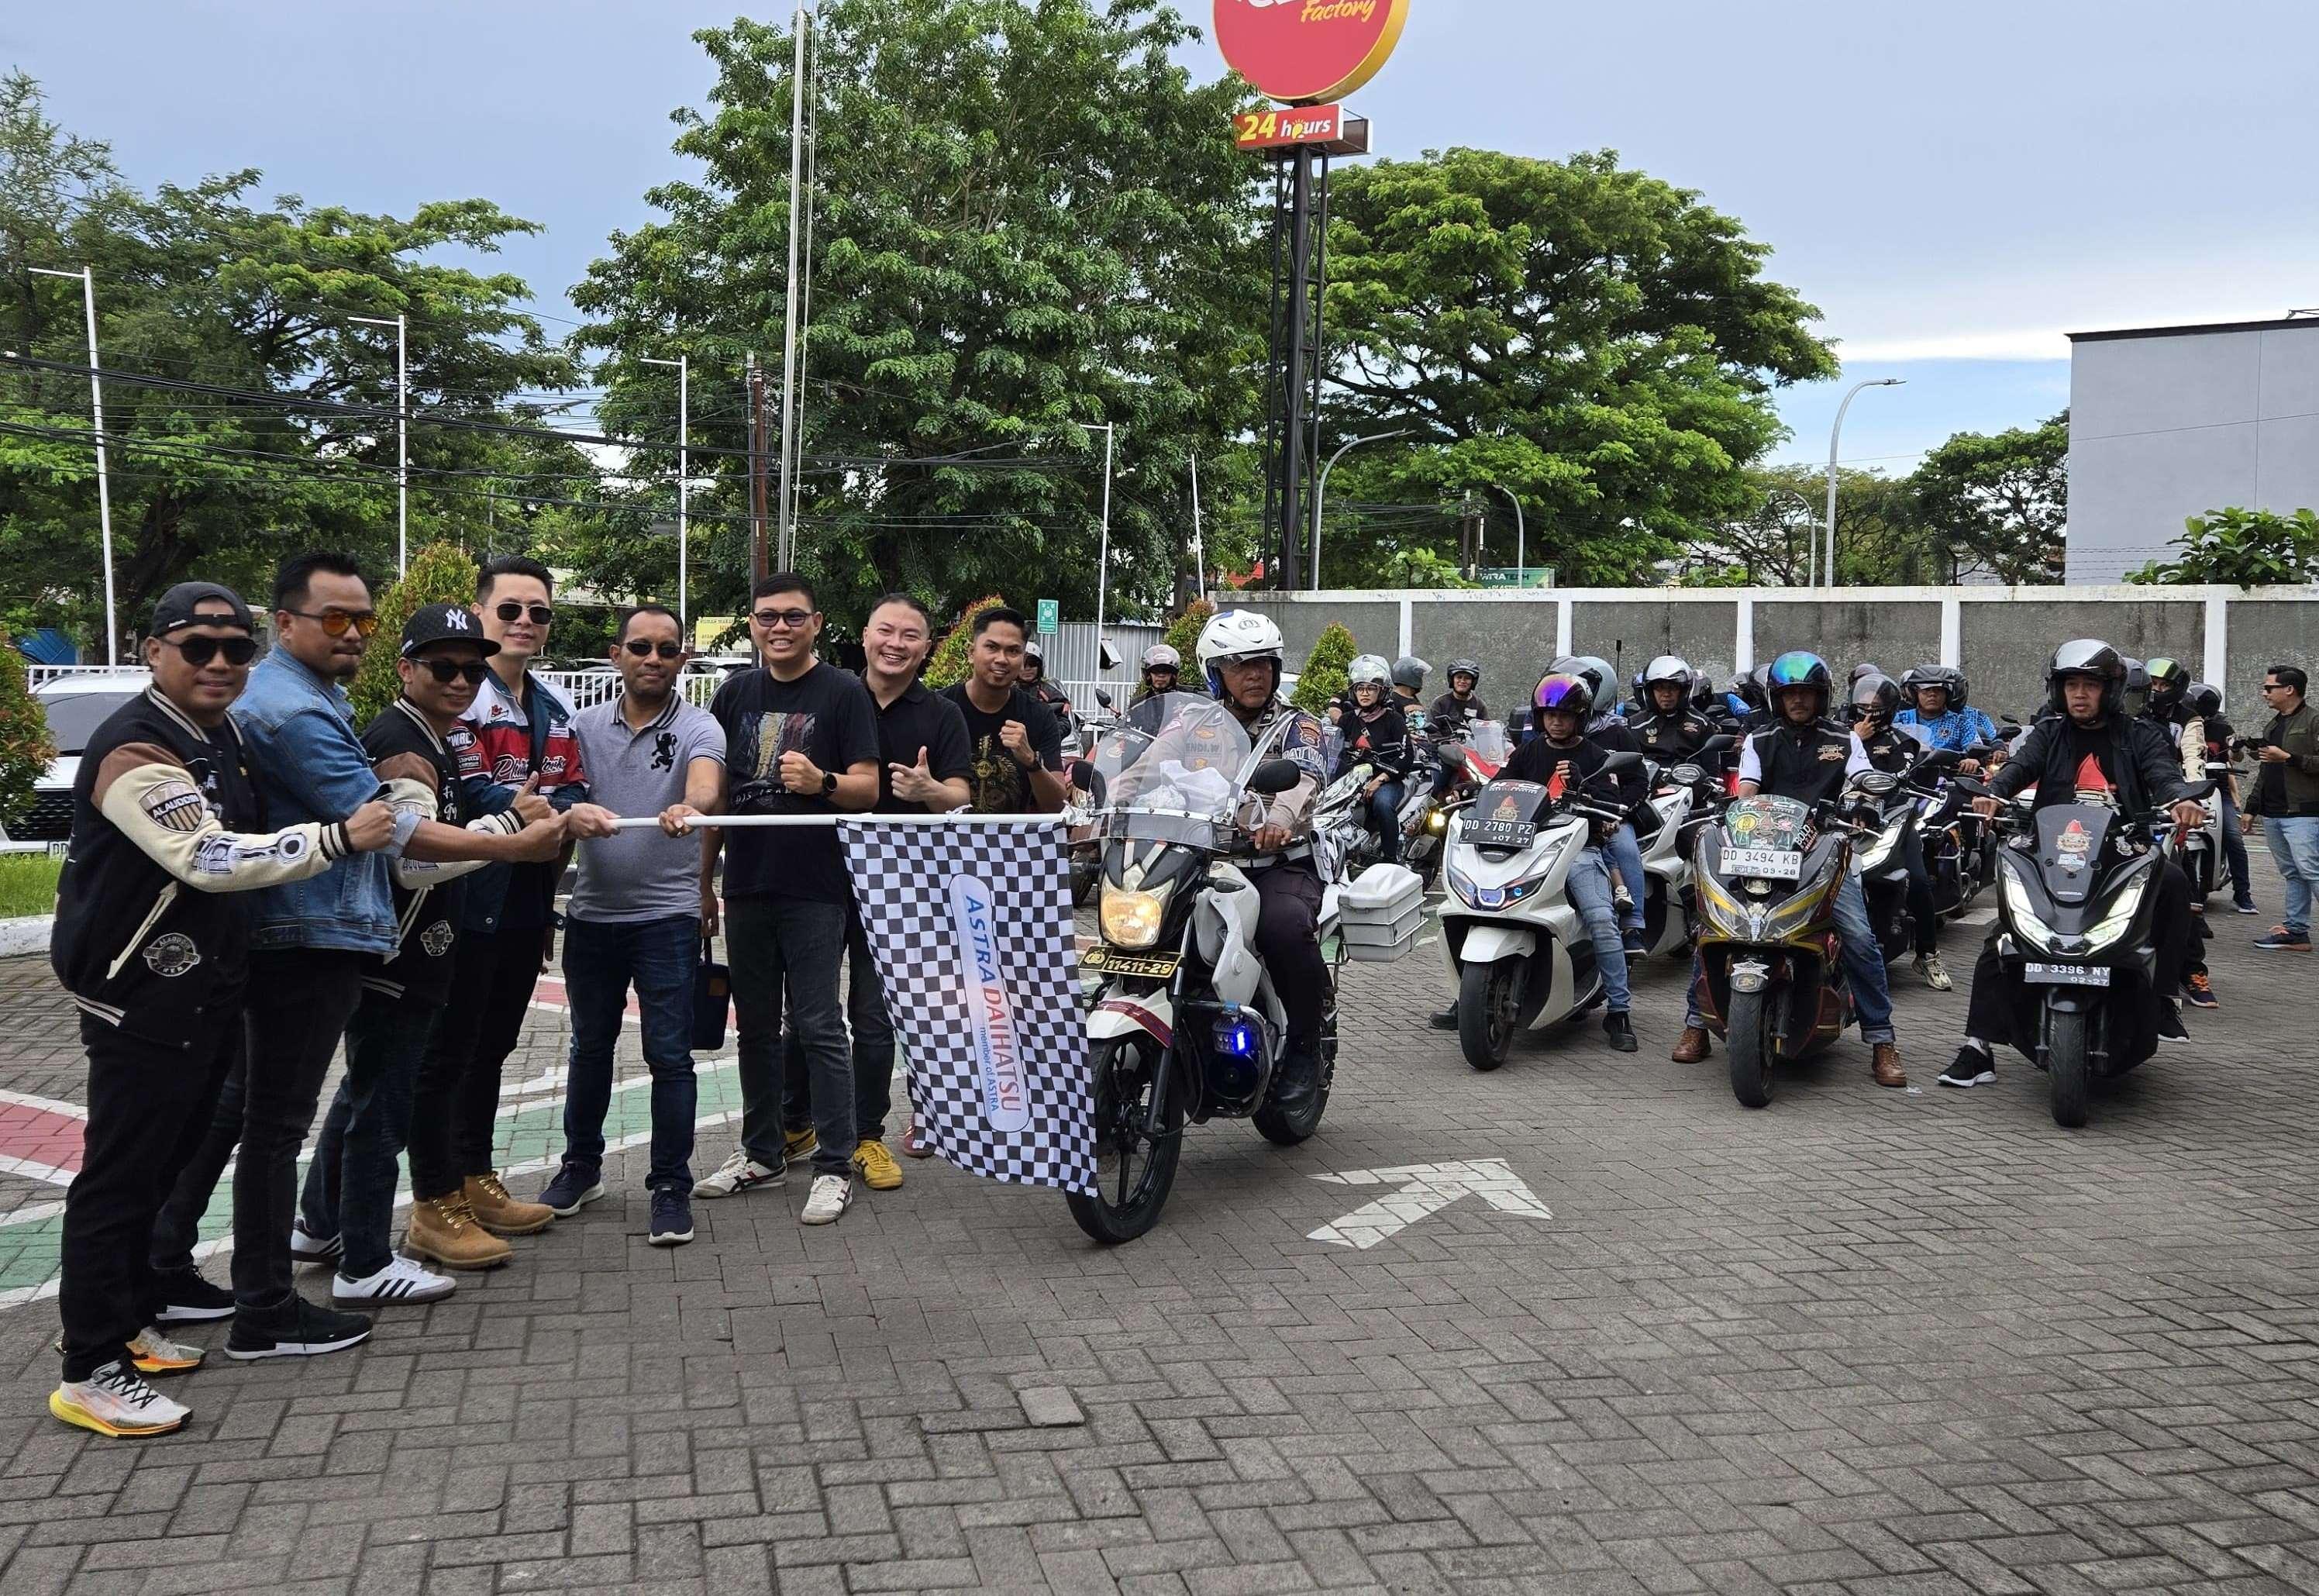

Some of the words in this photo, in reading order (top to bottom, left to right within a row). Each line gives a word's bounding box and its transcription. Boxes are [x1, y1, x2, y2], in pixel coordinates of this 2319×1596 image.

[1301, 0, 1377, 22] Factory
[1240, 113, 1277, 141] 24
[1464, 819, 1479, 830] DD
[1483, 822, 1512, 832] 2780
[1518, 824, 1533, 835] PZ
[1723, 850, 1737, 860] DD
[1745, 852, 1774, 863] 3494
[1783, 854, 1799, 865] KB
[2025, 962, 2042, 972] DD
[2050, 964, 2085, 975] 3396
[965, 894, 996, 984] ASTRA
[983, 988, 1022, 1111] DAIHATSU
[980, 1027, 991, 1064] member
[986, 1067, 995, 1075] of
[987, 1078, 999, 1112] ASTRA
